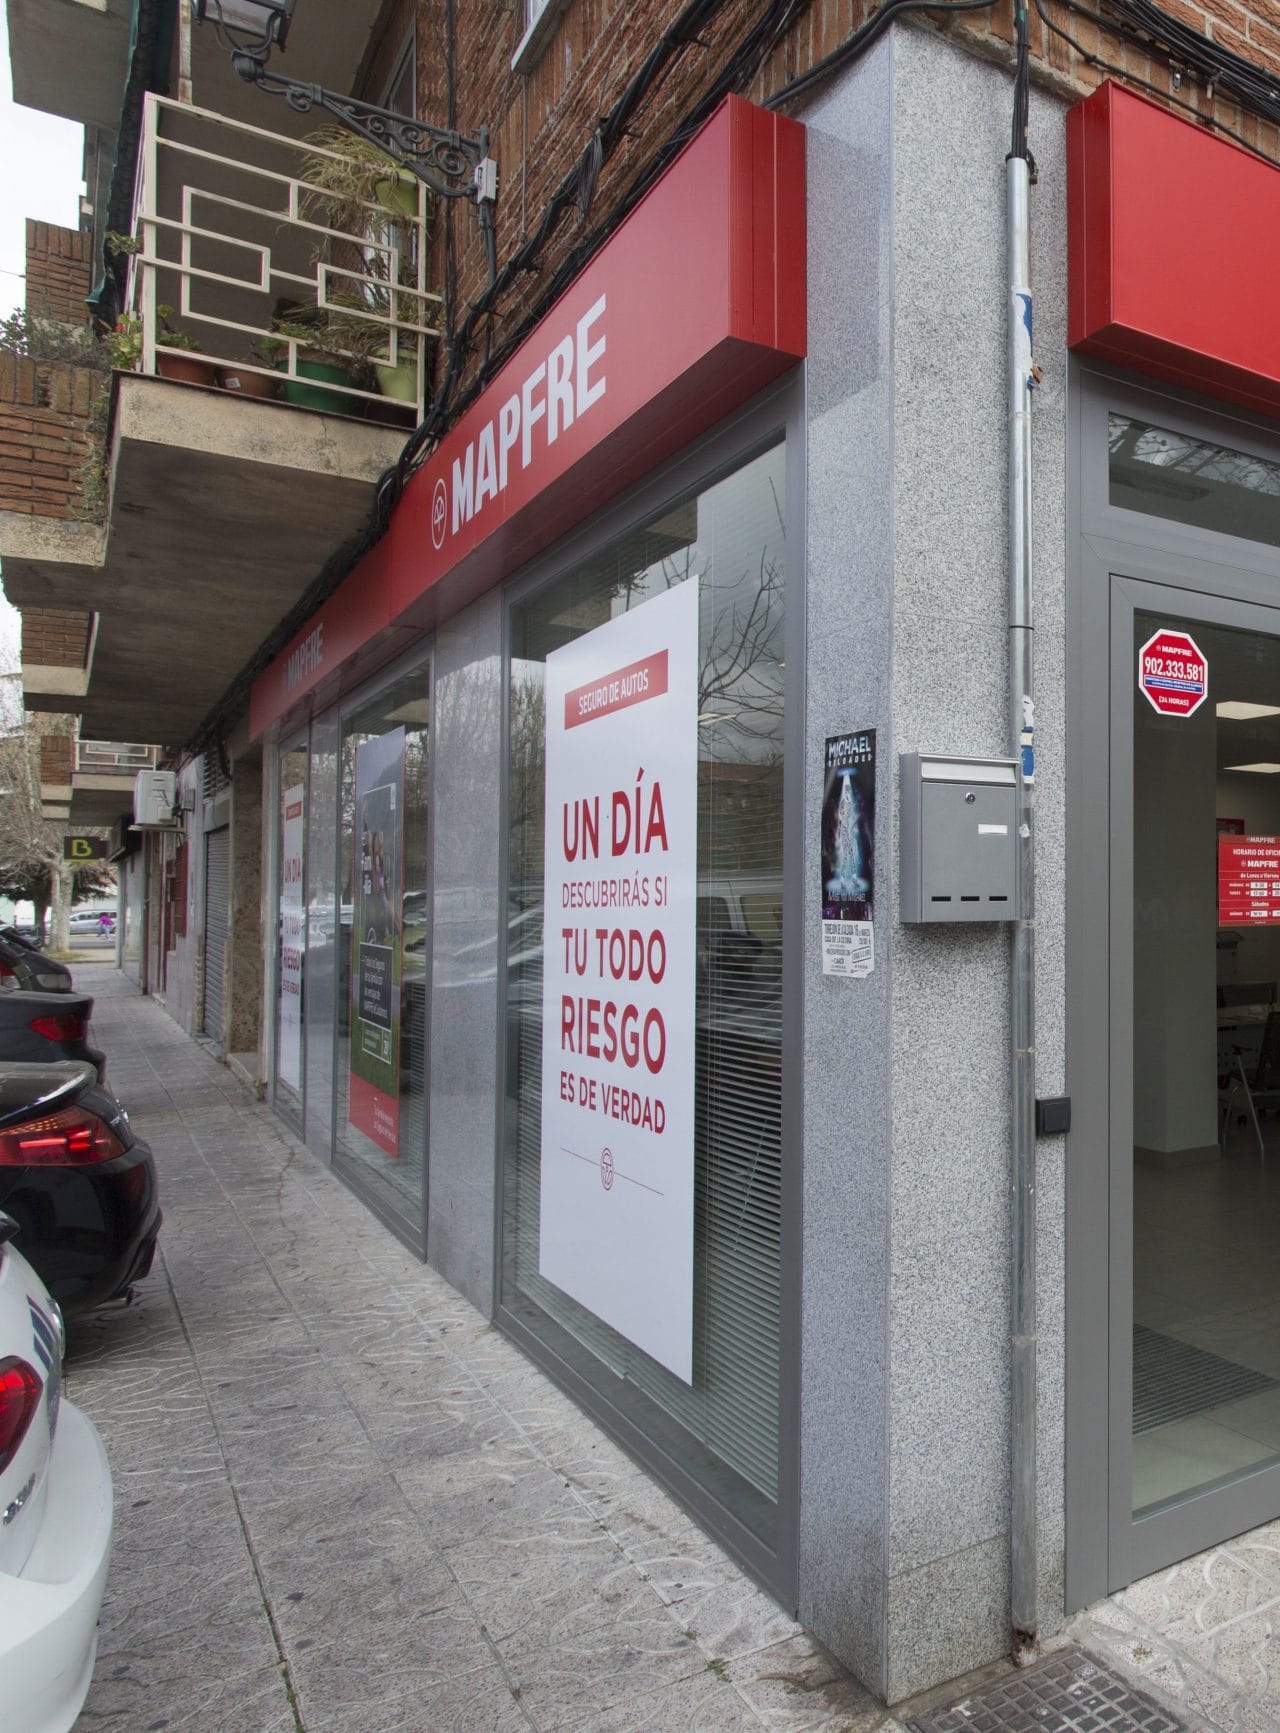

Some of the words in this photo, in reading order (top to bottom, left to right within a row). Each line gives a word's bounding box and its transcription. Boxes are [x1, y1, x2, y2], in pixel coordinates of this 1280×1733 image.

[452, 293, 606, 535] MAPFRE
[1145, 657, 1203, 681] 902.333.581
[1161, 645, 1192, 656] MAPFRE
[578, 688, 608, 716] SEGURO
[608, 684, 619, 702] DE
[620, 668, 649, 698] AUTOS
[828, 736, 871, 758] MICHAEL
[563, 796, 599, 862] UN
[611, 766, 669, 857] DÍA
[72, 840, 92, 857] B
[1247, 860, 1279, 868] MAPFRE
[562, 870, 649, 909] DESCUBRIRÁS
[654, 876, 667, 906] SI
[562, 928, 587, 976] TU
[596, 928, 666, 984] TODO
[561, 995, 666, 1074] RIESGO
[560, 1071, 575, 1102] ES
[579, 1077, 597, 1111] DE
[601, 1082, 666, 1134] VERDAD
